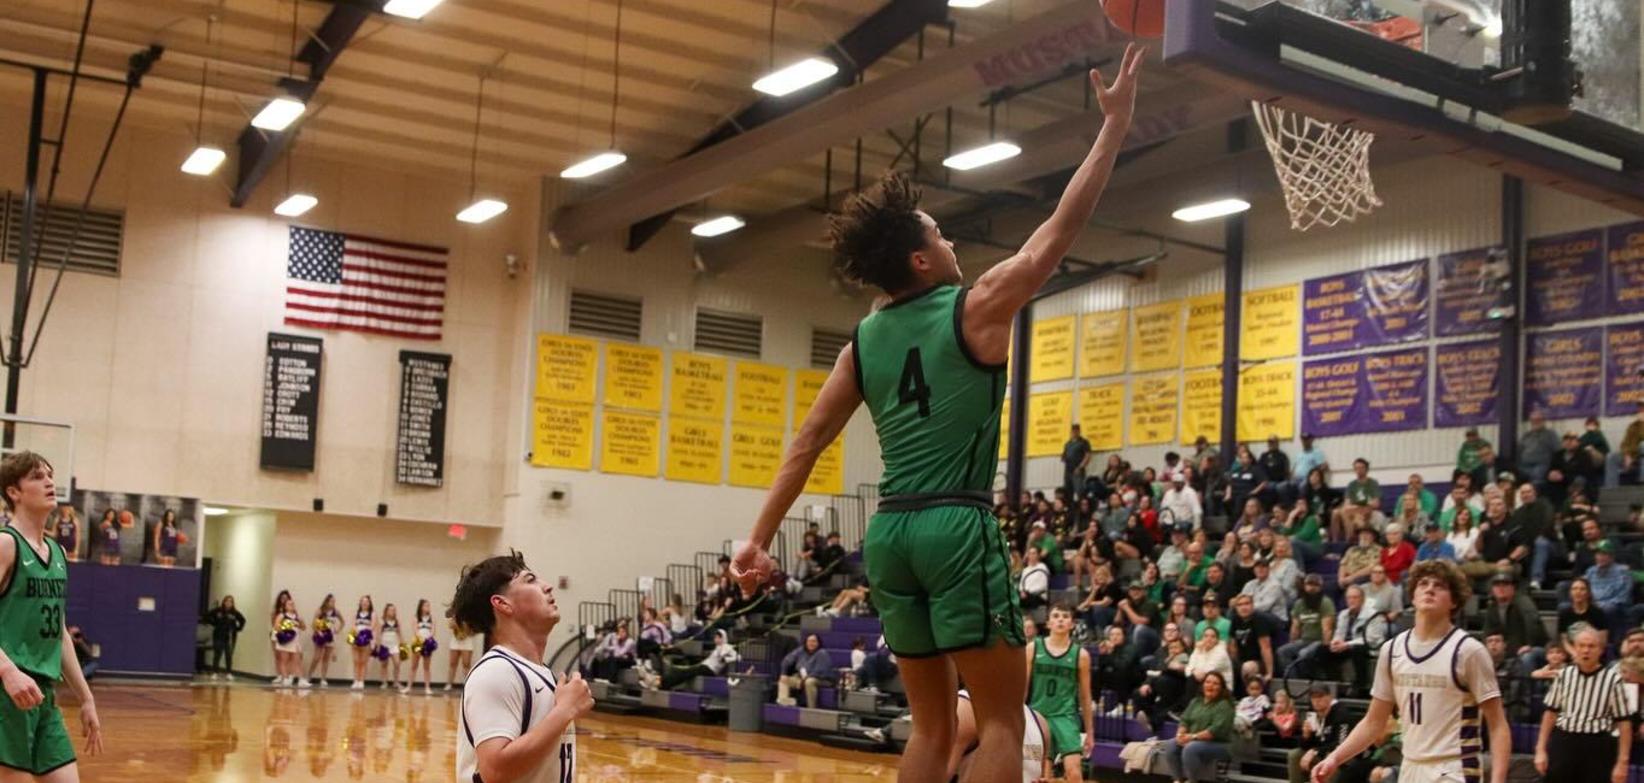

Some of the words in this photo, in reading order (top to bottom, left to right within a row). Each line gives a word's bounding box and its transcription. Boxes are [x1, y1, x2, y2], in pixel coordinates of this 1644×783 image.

[1321, 281, 1344, 293] BOYS
[1247, 290, 1294, 305] SOFTBALL
[1393, 352, 1425, 366] TRACK
[675, 368, 724, 382] BASKETBALL
[1305, 363, 1331, 379] BOYS
[1332, 360, 1360, 376] GOLF
[898, 346, 931, 418] 4
[1243, 376, 1264, 386] BOYS
[1266, 371, 1292, 383] TRACK
[540, 423, 584, 434] CHAMPIONS
[670, 435, 720, 449] BASKETBALL
[733, 433, 755, 445] GIRLS
[761, 435, 782, 447] GOLF
[27, 577, 66, 598] BURNE
[40, 604, 60, 639] 33
[1046, 679, 1057, 698] 0
[1409, 692, 1422, 725] 11
